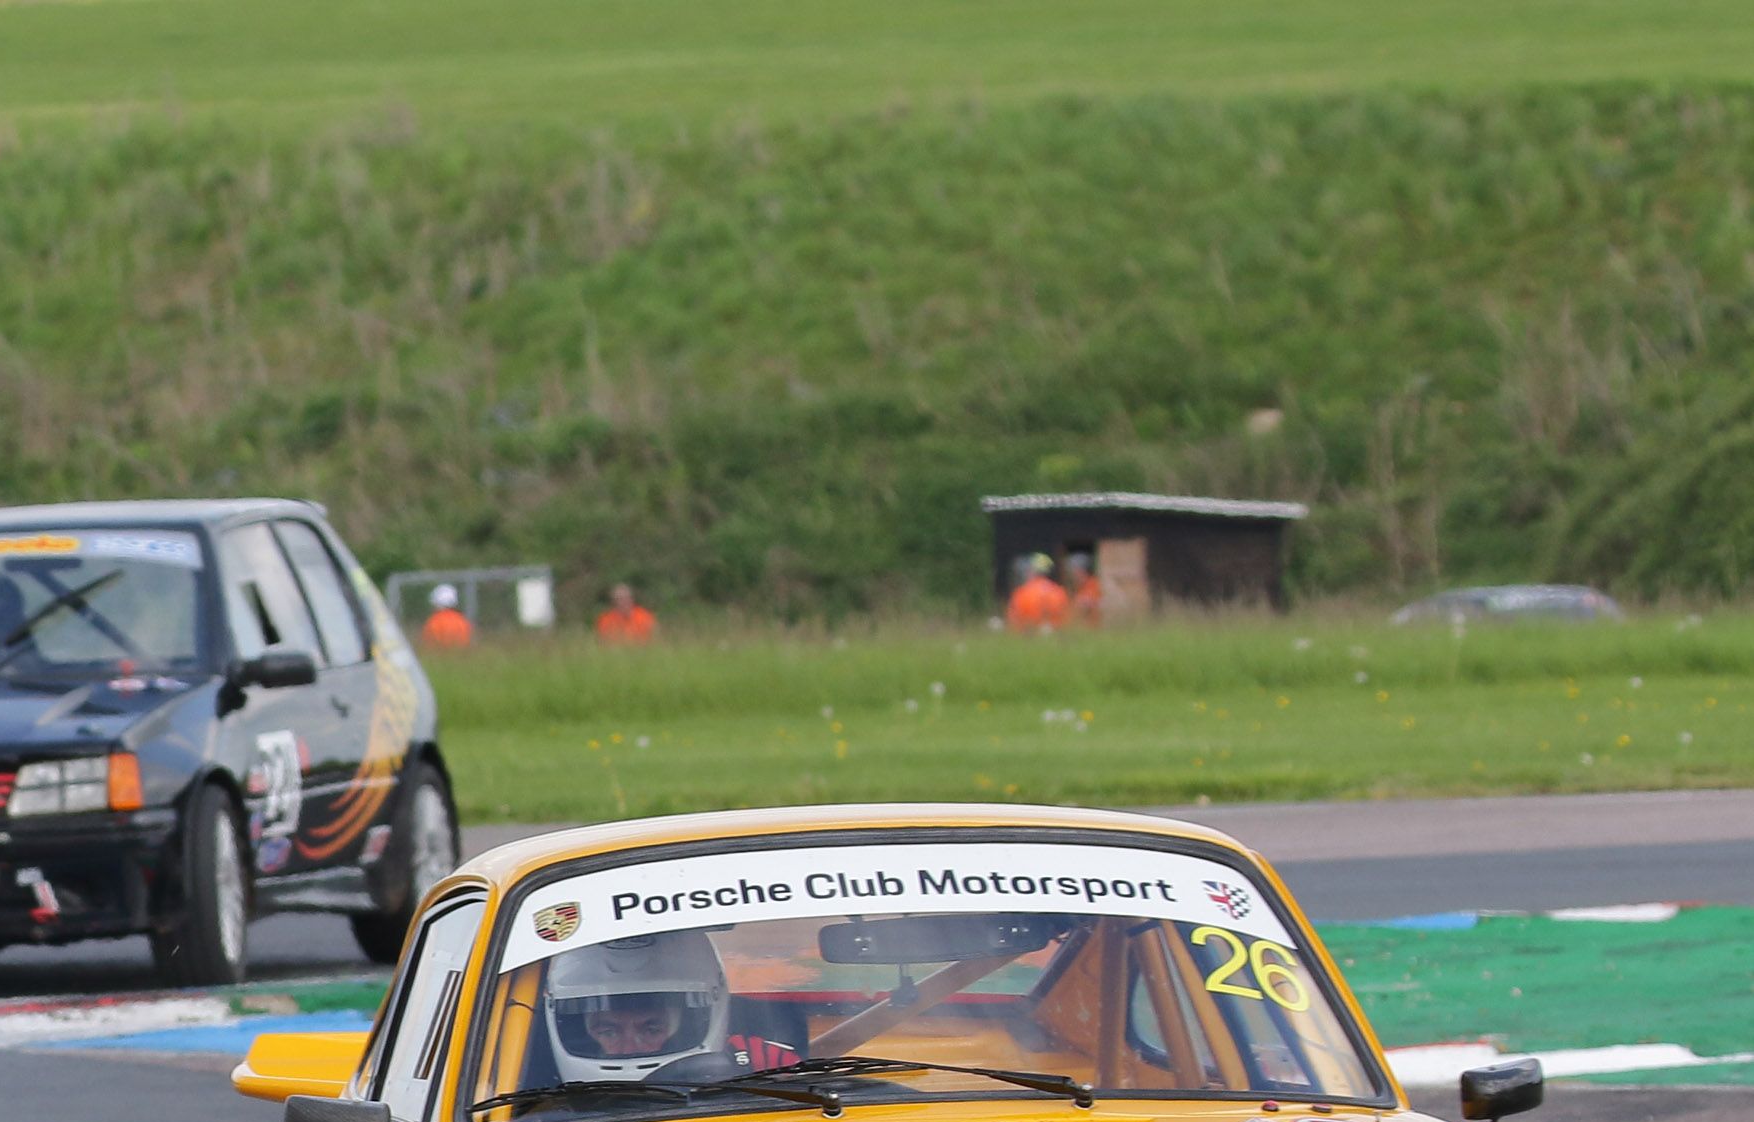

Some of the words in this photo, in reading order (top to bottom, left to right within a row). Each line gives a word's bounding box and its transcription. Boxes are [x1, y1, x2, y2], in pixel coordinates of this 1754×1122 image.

[612, 878, 793, 920] Porsche
[805, 871, 904, 899] Club
[918, 869, 1177, 902] Motorsport
[1191, 926, 1310, 1012] 26
